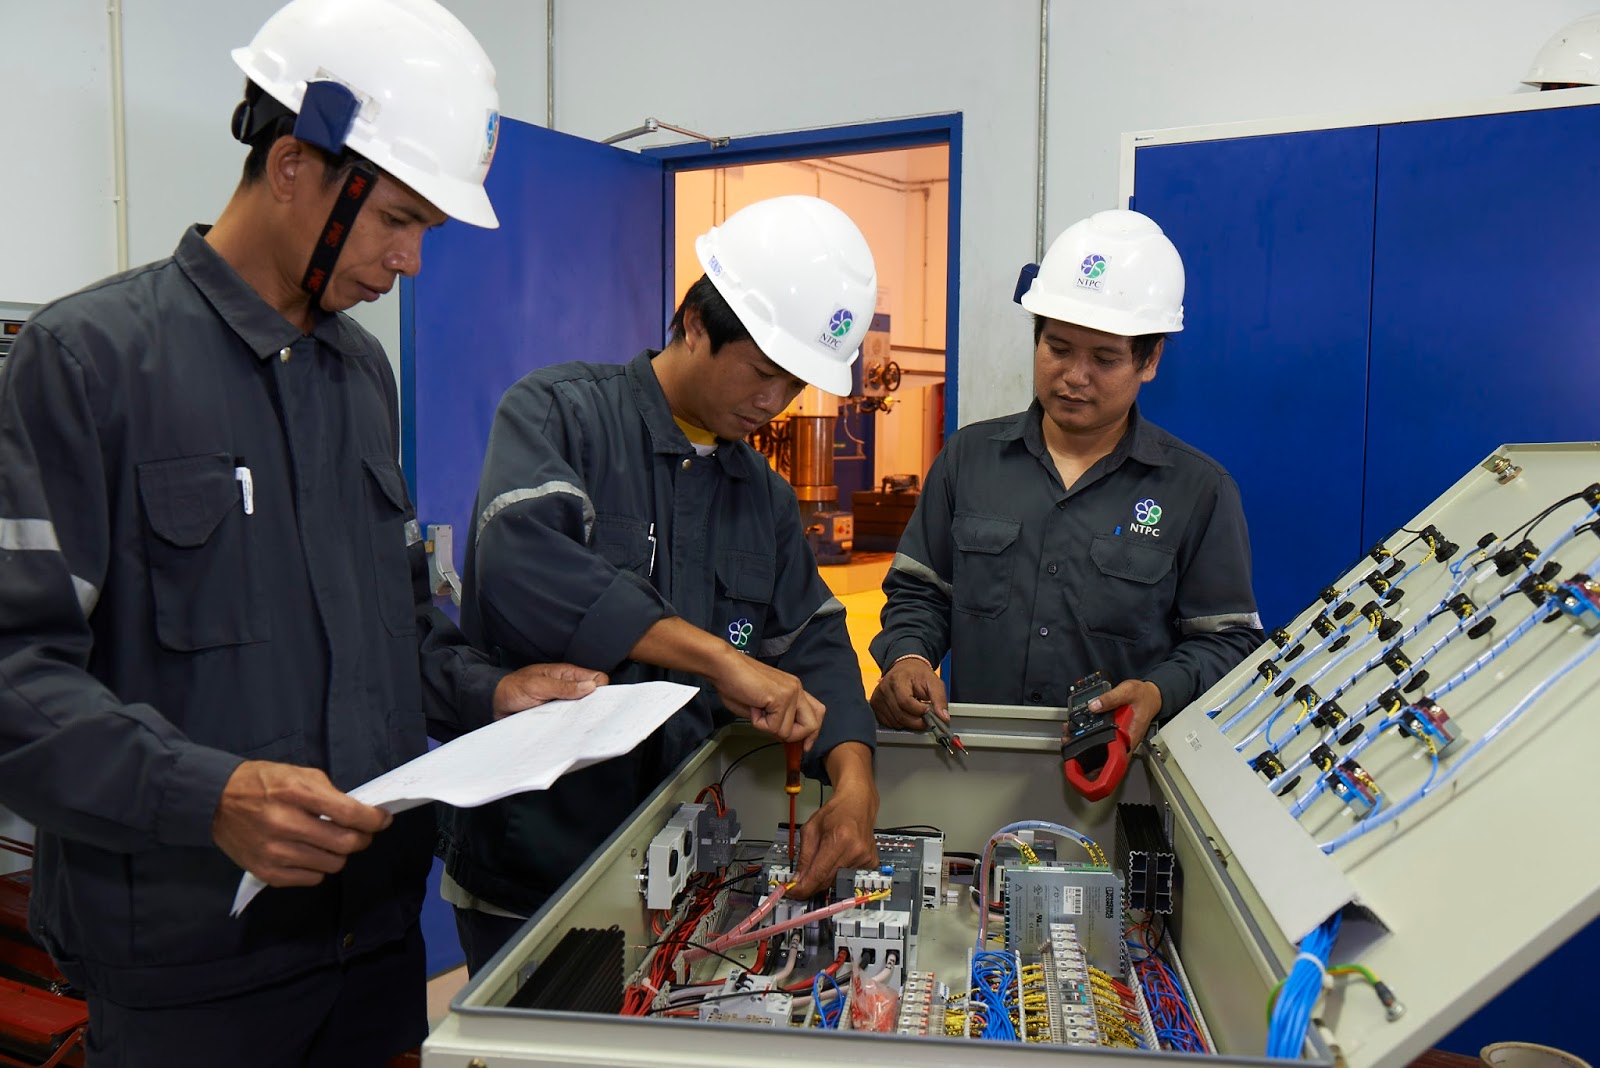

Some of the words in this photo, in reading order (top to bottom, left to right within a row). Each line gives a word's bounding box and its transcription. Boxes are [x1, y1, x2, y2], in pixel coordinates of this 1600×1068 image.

[348, 175, 366, 198] 3M
[1077, 277, 1102, 289] NTPC
[820, 333, 842, 348] NTPC
[1130, 522, 1160, 537] NTPC
